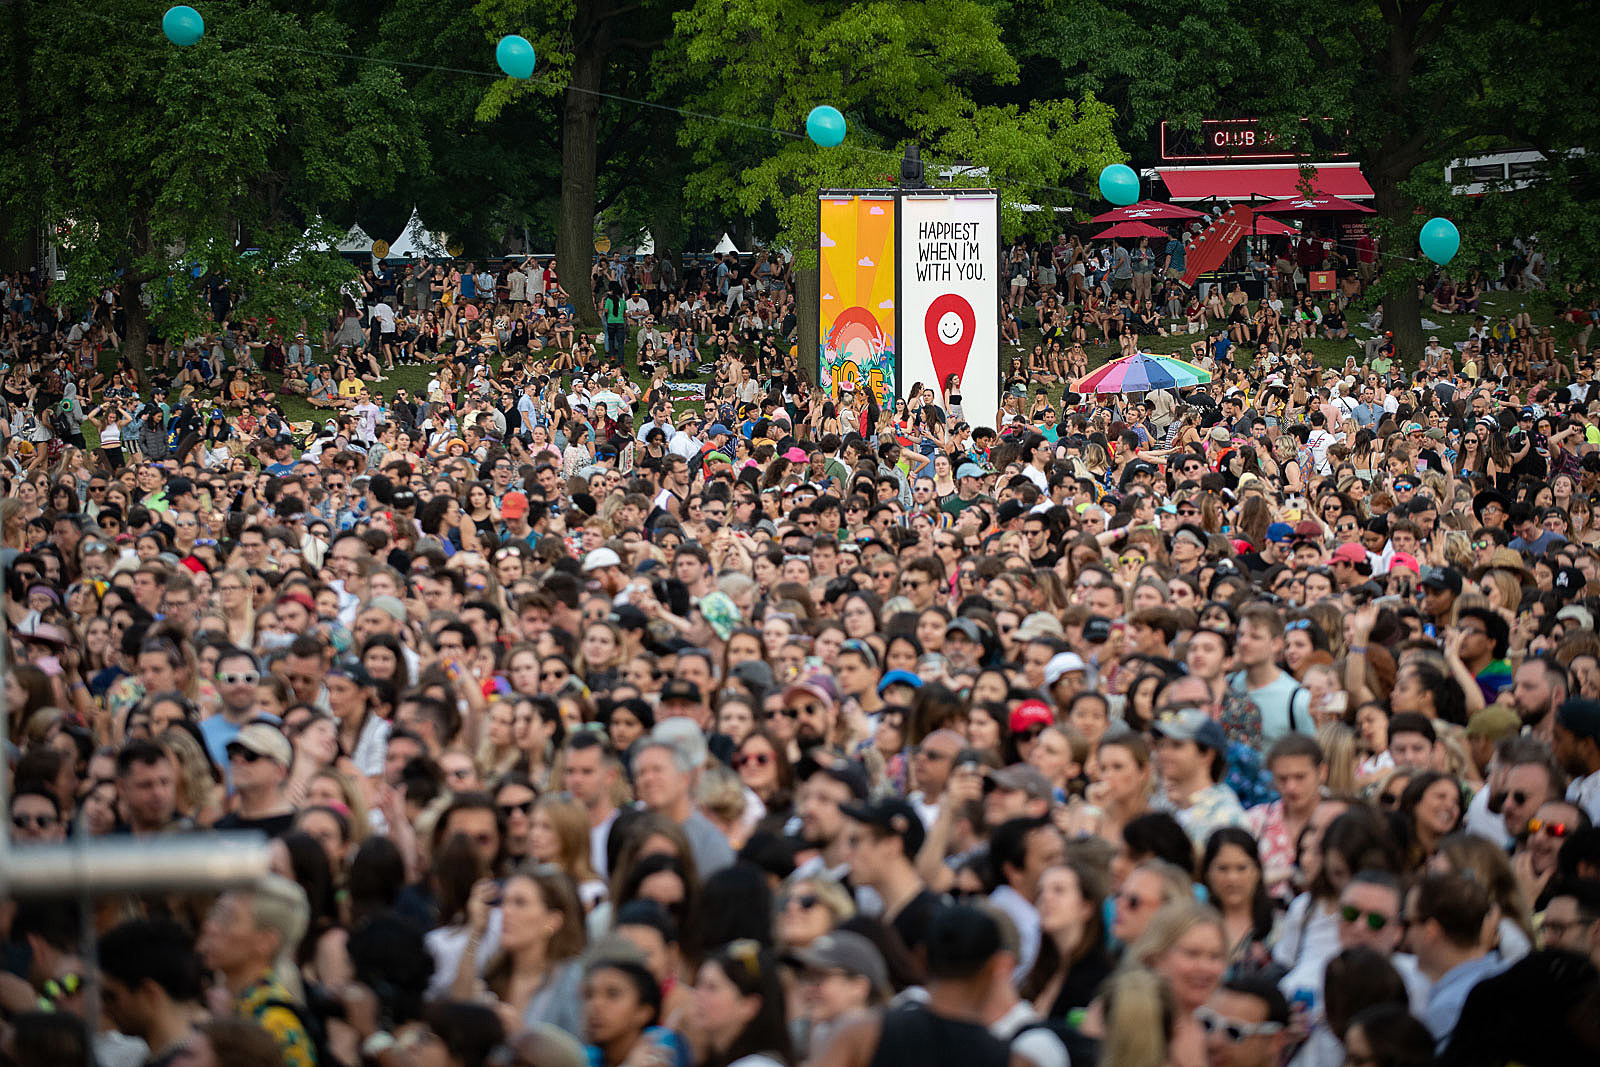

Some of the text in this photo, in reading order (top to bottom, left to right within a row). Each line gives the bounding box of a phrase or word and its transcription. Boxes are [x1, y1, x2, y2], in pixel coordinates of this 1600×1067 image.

[1214, 131, 1255, 146] CLUB
[919, 221, 980, 241] HAPPIEST
[918, 241, 979, 262] WHEN I'M
[916, 262, 986, 282] WITH YOU.
